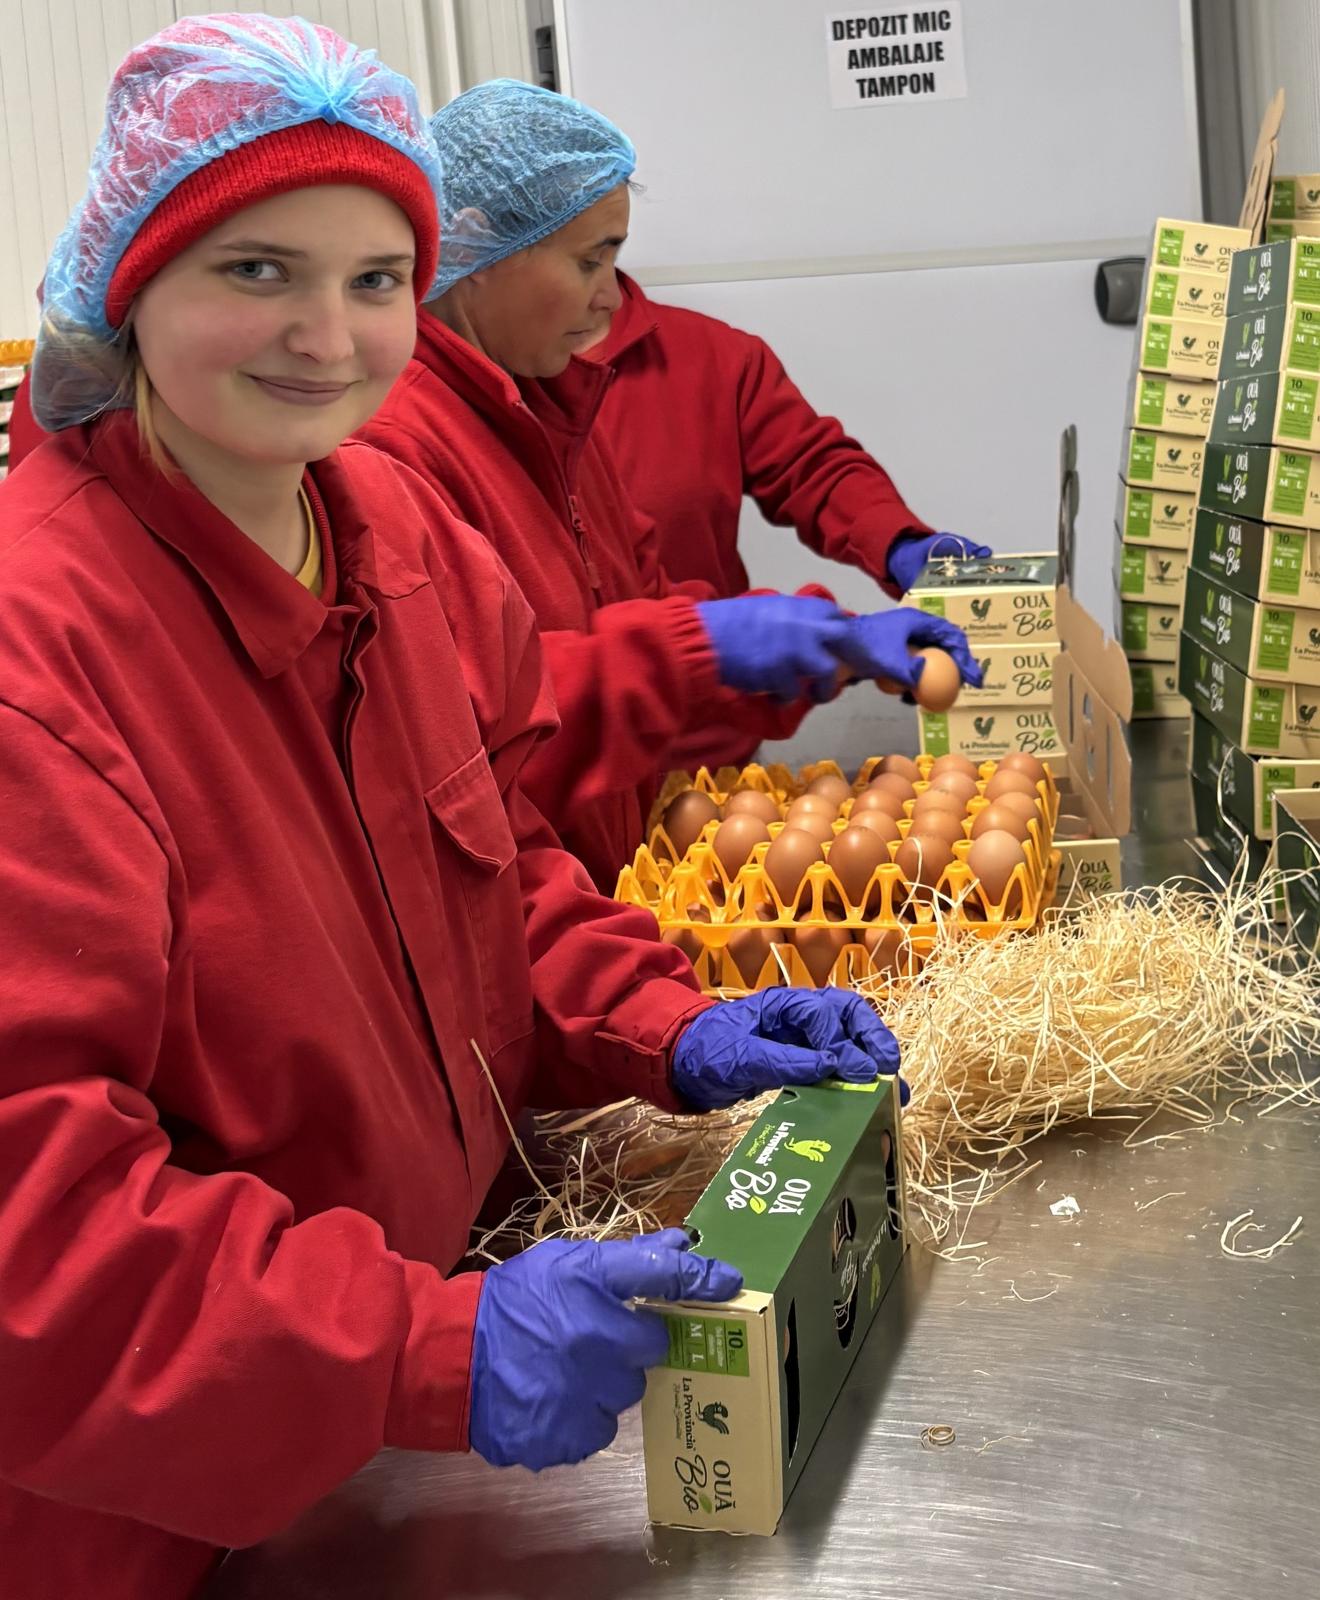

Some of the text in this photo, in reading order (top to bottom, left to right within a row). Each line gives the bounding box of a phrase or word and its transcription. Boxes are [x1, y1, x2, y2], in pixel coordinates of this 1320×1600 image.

[832, 10, 951, 41] DEPOZIT MIC
[848, 41, 944, 70] AMBALAJE
[856, 72, 935, 98] TAMPON
[1303, 245, 1314, 256] 10
[1298, 268, 1308, 278] M
[1301, 311, 1312, 321] 10
[1295, 334, 1320, 346] M L
[1291, 379, 1302, 389] 10
[1285, 402, 1310, 414] M L
[1284, 454, 1296, 464] 10
[1278, 478, 1303, 489] M L
[1278, 534, 1290, 544] 10
[1273, 558, 1297, 568] M L
[1012, 593, 1050, 609] OUĂ
[1268, 611, 1280, 621] 10
[1012, 612, 1054, 636] Bio
[1263, 634, 1288, 645] M L
[1012, 672, 1052, 696] Bio
[1258, 688, 1270, 698] 10
[1253, 712, 1278, 722] M L
[1016, 731, 1058, 754] Bio
[1268, 768, 1280, 778] 10
[725, 1168, 777, 1210] Bio
[768, 1178, 812, 1216] OUĂ
[690, 1322, 704, 1363] M L
[727, 1328, 743, 1349] 10
[682, 1377, 692, 1392] La
[674, 1454, 708, 1514] Bio
[712, 1460, 736, 1512] OUĂ
